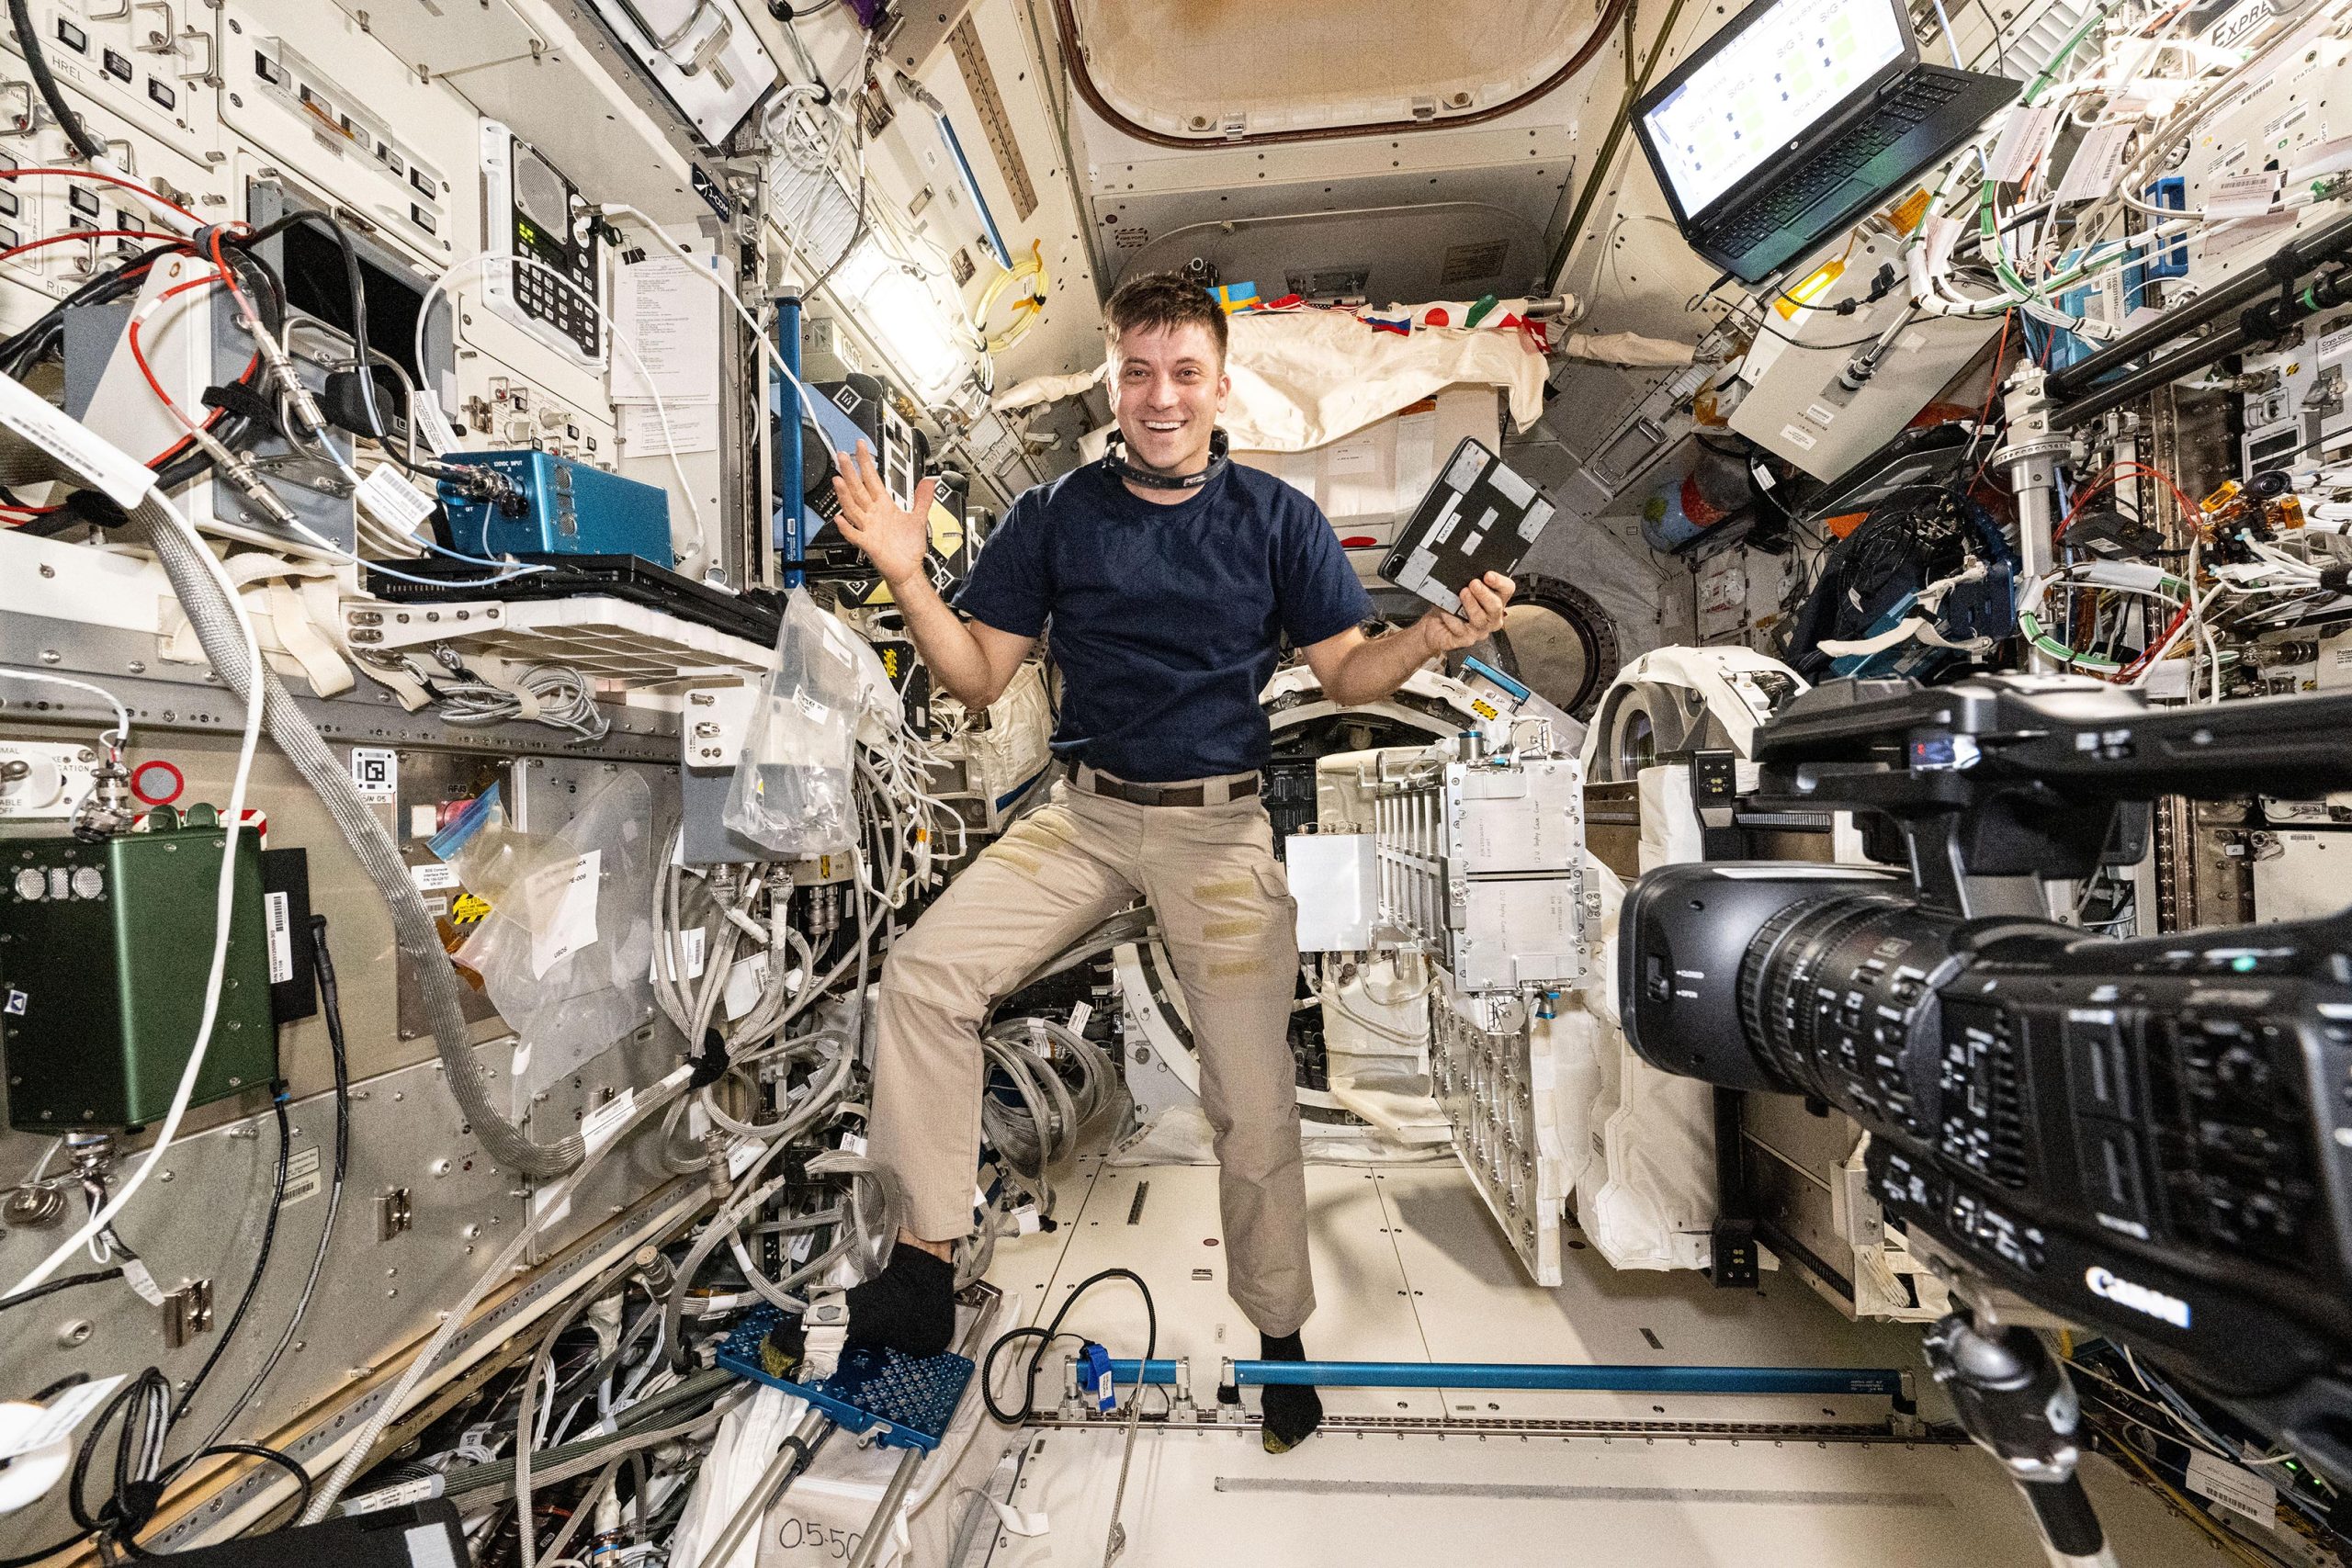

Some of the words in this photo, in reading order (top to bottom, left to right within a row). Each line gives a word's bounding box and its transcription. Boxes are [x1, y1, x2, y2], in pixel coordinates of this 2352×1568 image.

[2211, 1, 2270, 46] EXPRE
[51, 55, 85, 84] HREL
[709, 188, 729, 215] J-COM
[2322, 336, 2337, 348] Cryo
[458, 1150, 478, 1163] ERROR
